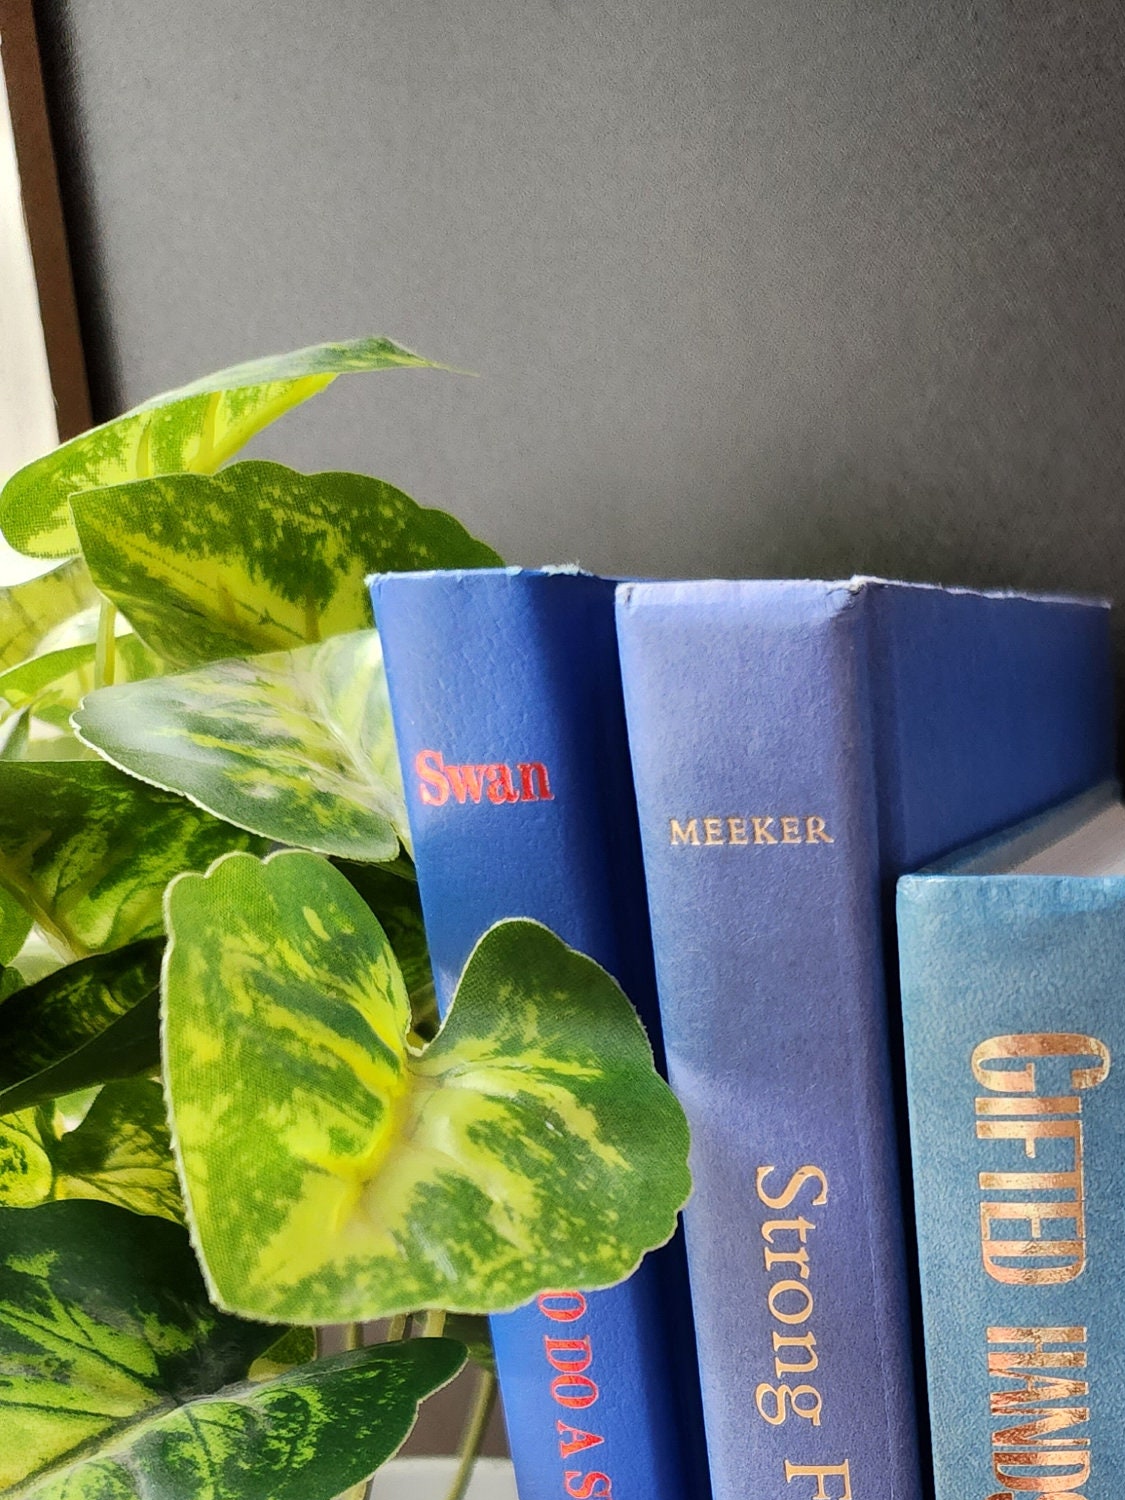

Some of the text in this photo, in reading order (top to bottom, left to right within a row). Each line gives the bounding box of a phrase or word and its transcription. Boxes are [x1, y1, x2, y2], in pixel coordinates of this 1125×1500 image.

[415, 749, 554, 807] Swan
[669, 815, 835, 845] MEEKER
[970, 1032, 1110, 1285] GIFTED
[755, 1165, 828, 1428] Strong
[543, 1335, 600, 1410] DO
[556, 1419, 605, 1459] A
